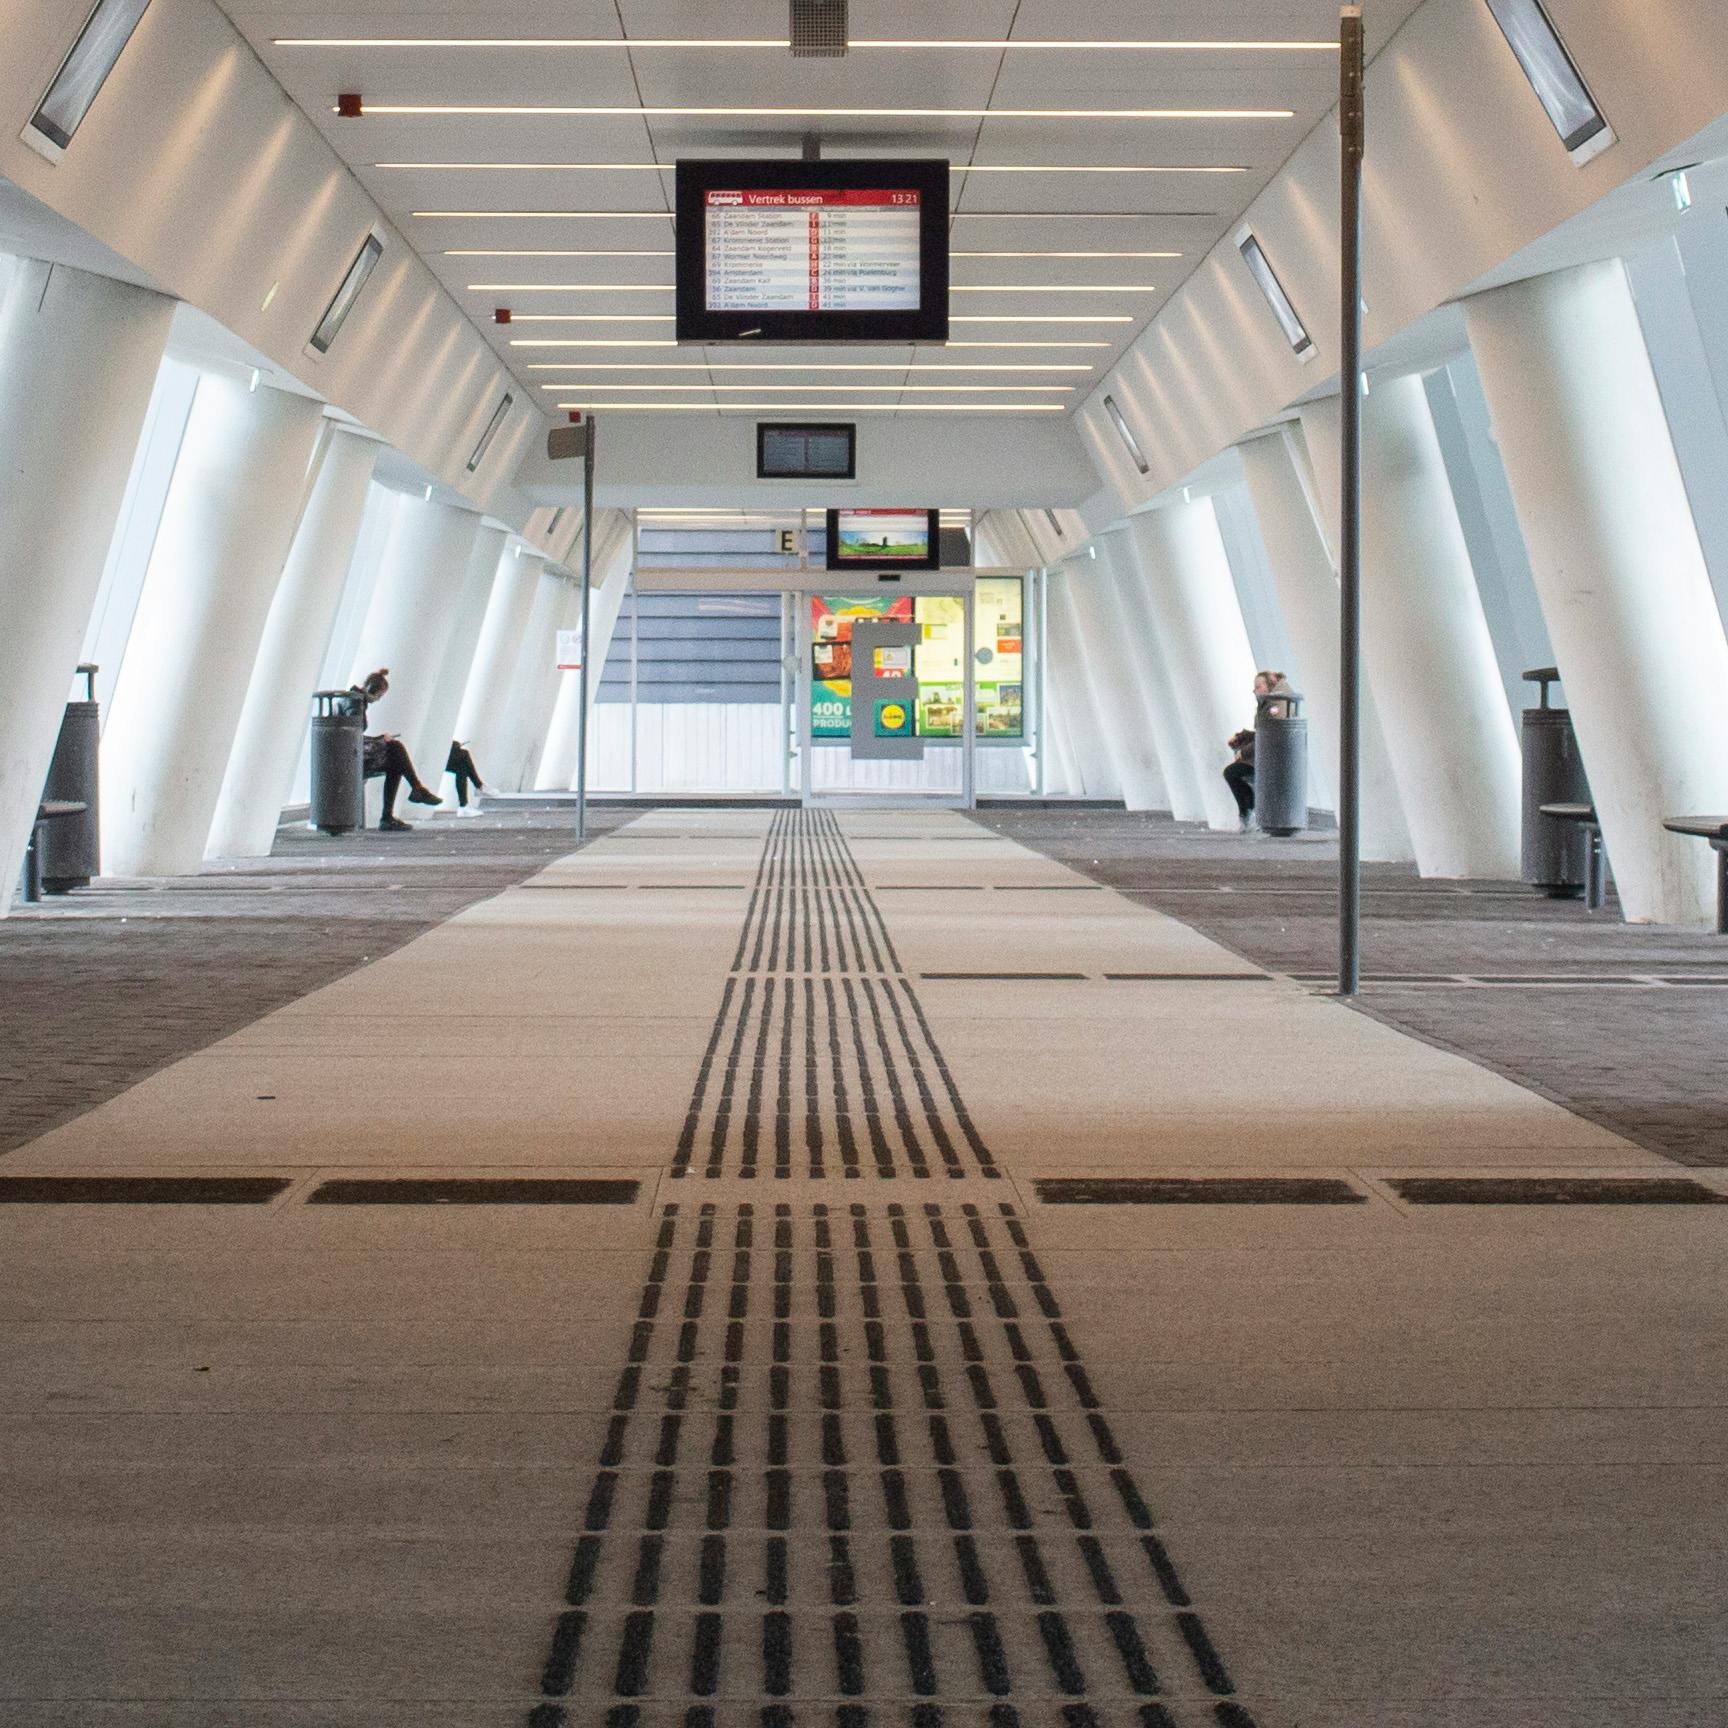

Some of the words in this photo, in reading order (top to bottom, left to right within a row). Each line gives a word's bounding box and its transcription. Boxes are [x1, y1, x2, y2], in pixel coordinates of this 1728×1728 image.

[749, 195, 785, 204] Vertrek
[788, 195, 823, 204] bussen
[781, 530, 793, 552] E
[813, 702, 844, 716] 400
[813, 719, 852, 728] PRODU
